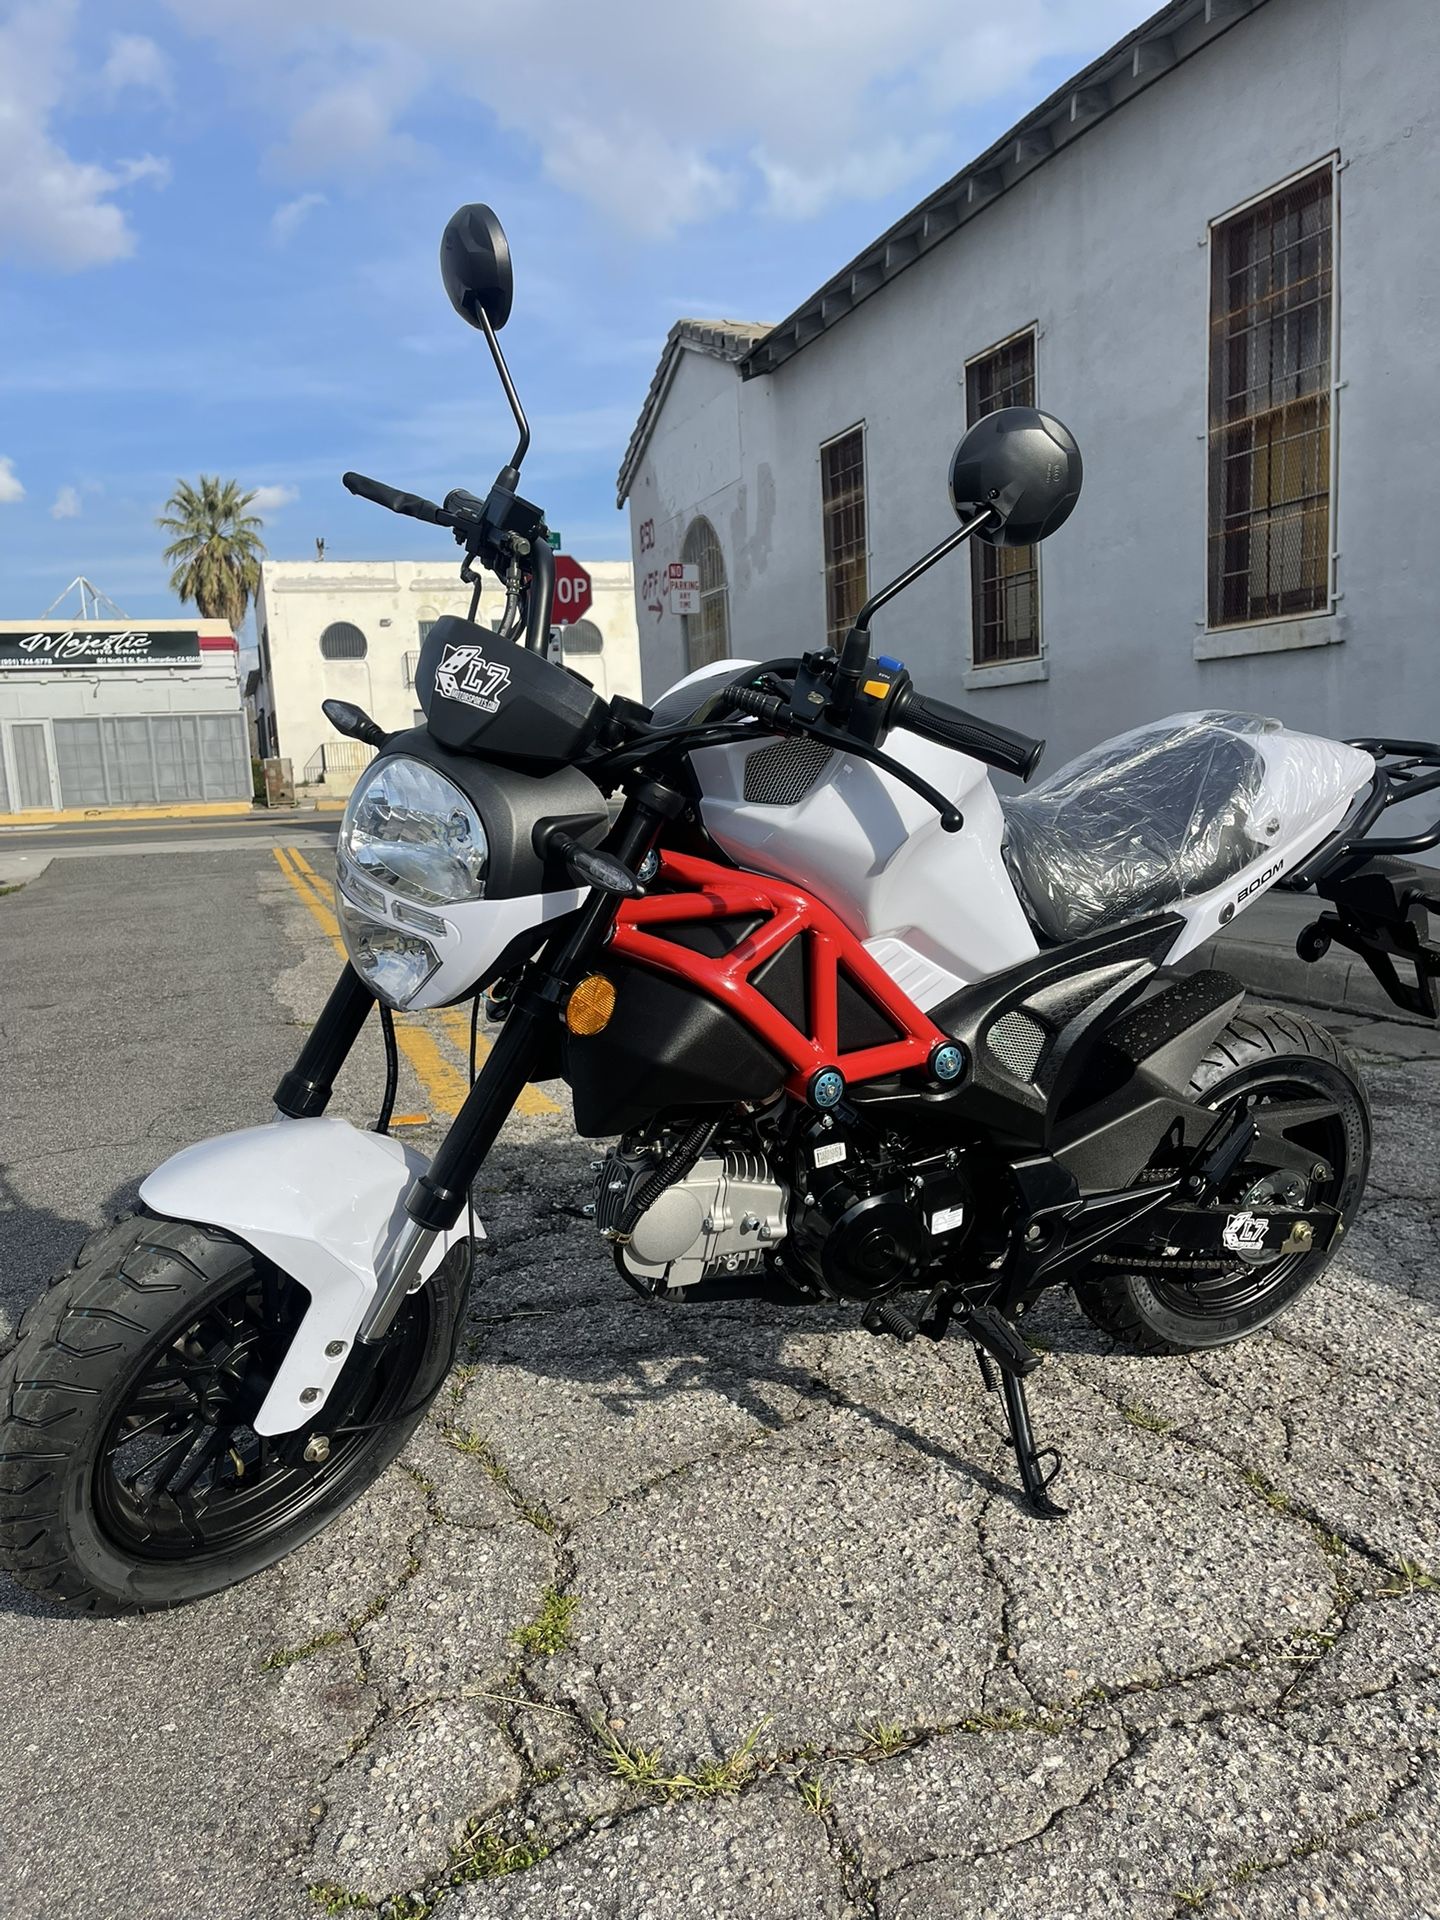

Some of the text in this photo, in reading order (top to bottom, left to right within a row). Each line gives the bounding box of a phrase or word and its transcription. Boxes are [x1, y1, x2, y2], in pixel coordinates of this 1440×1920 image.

[670, 565, 682, 577] NO
[557, 577, 588, 604] OP
[642, 571, 668, 600] OFFIC
[671, 581, 699, 590] PARKING
[19, 631, 152, 658] Majestic
[461, 661, 508, 696] L7
[1237, 858, 1284, 904] BOOM
[1239, 1220, 1267, 1241] L7
